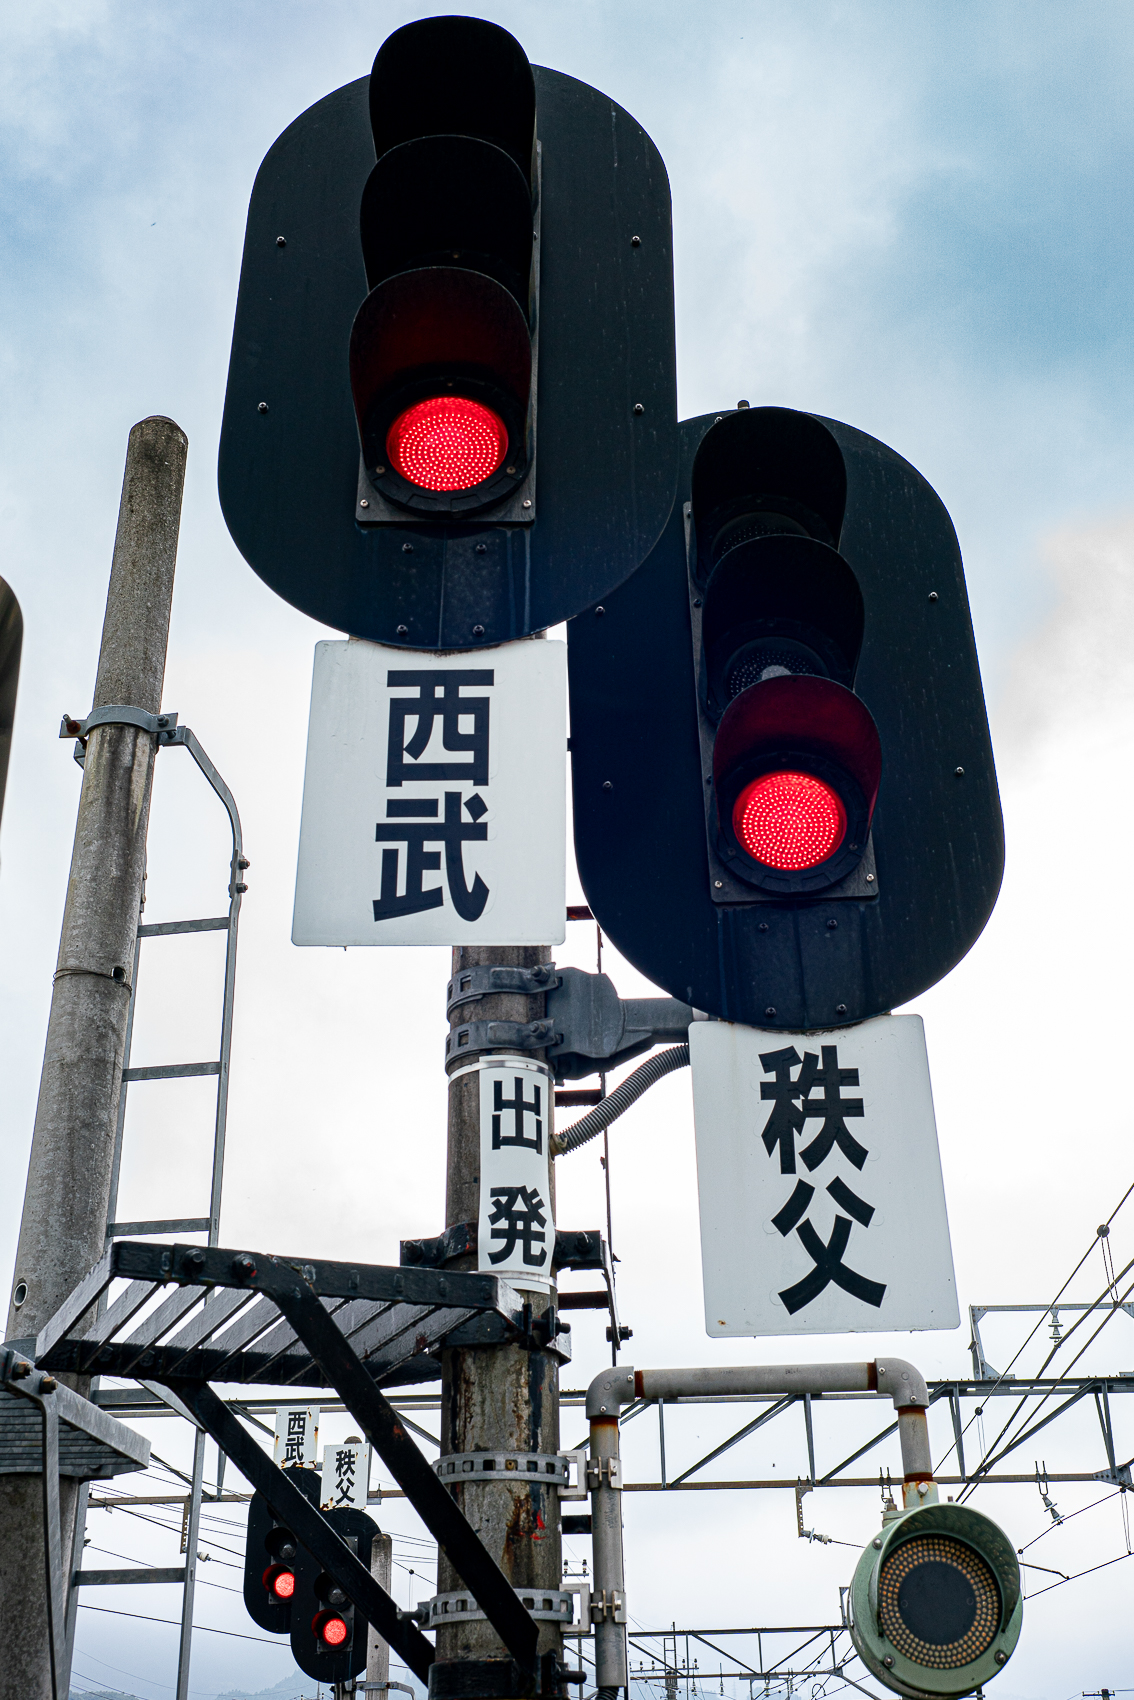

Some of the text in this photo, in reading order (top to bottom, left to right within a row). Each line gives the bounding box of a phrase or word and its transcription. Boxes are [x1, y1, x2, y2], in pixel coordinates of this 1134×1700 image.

[373, 669, 494, 922] 西武
[488, 1077, 547, 1267] 出発
[758, 1045, 887, 1315] 秩父
[285, 1411, 307, 1462] 西武
[335, 1449, 356, 1505] 秩父
